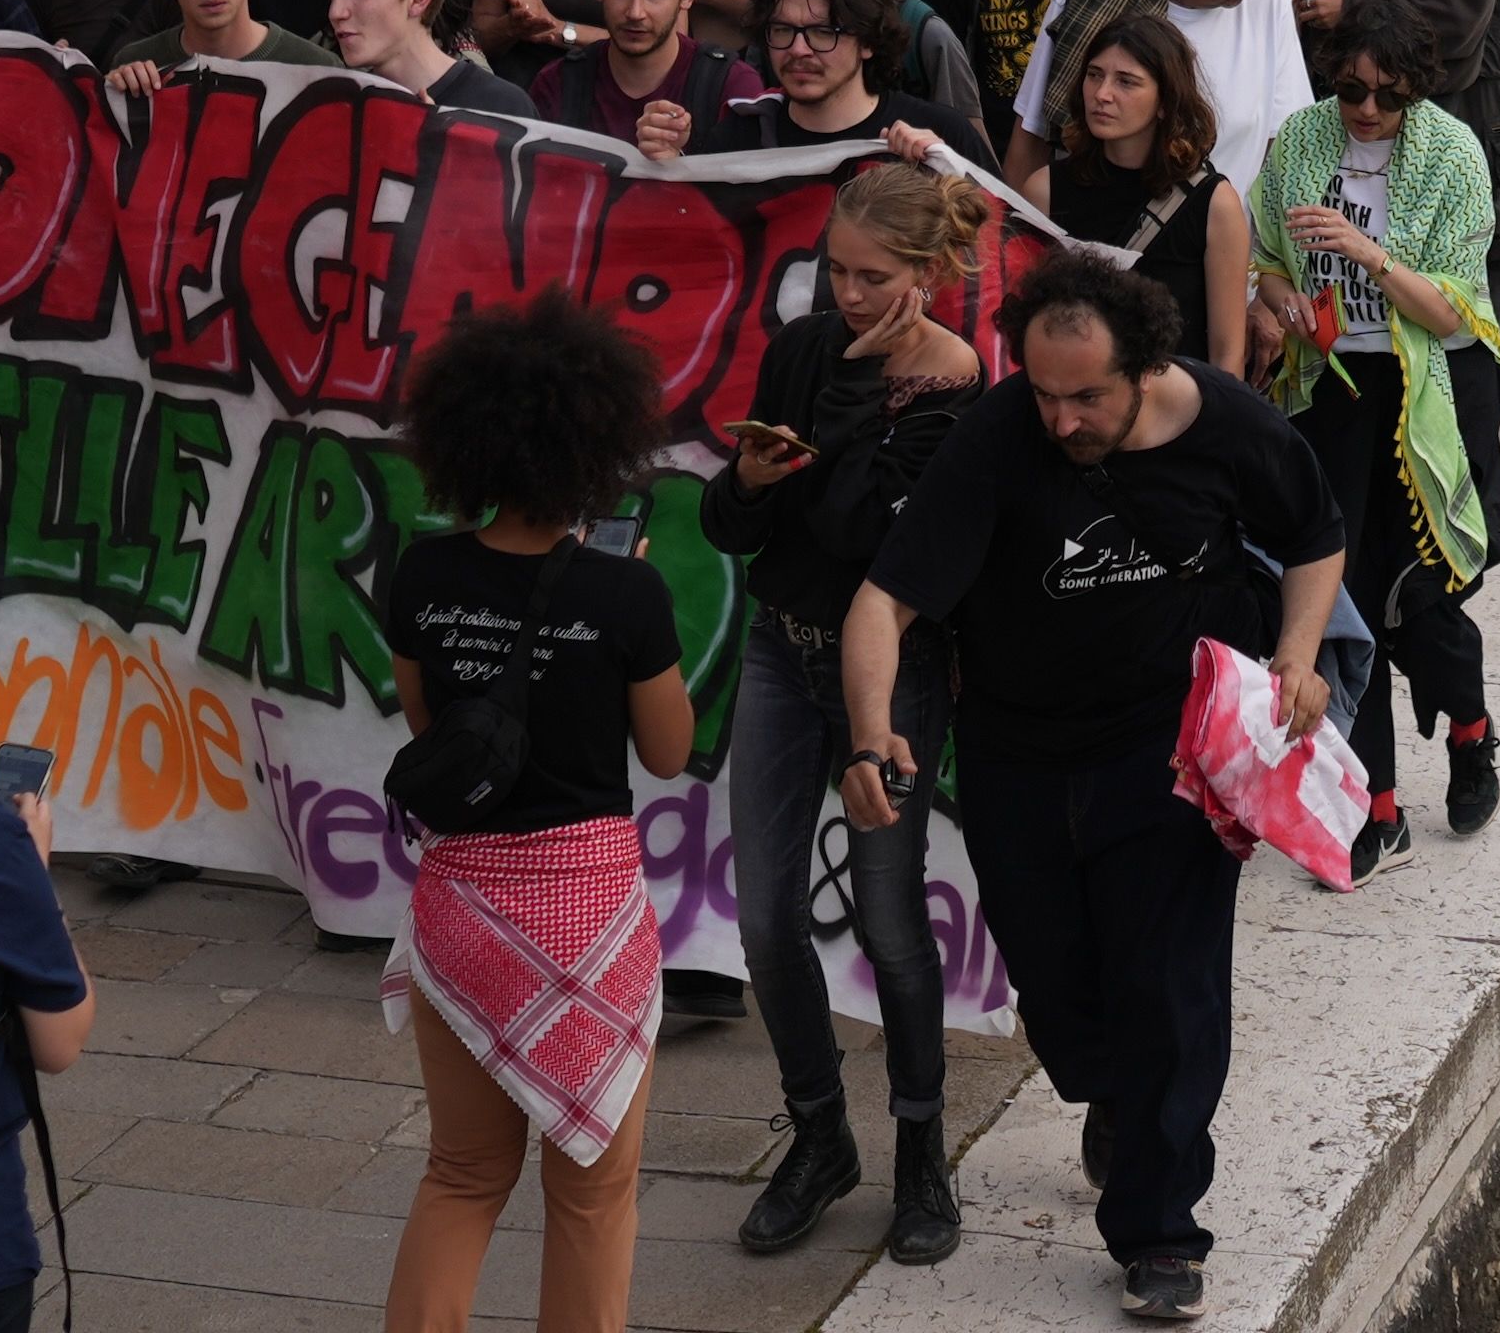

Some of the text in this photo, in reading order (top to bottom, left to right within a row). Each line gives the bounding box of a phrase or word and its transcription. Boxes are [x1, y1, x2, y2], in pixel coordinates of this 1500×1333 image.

[980, 11, 1029, 31] KINGS
[1309, 252, 1332, 276] NO
[1059, 576, 1098, 590] SONIC
